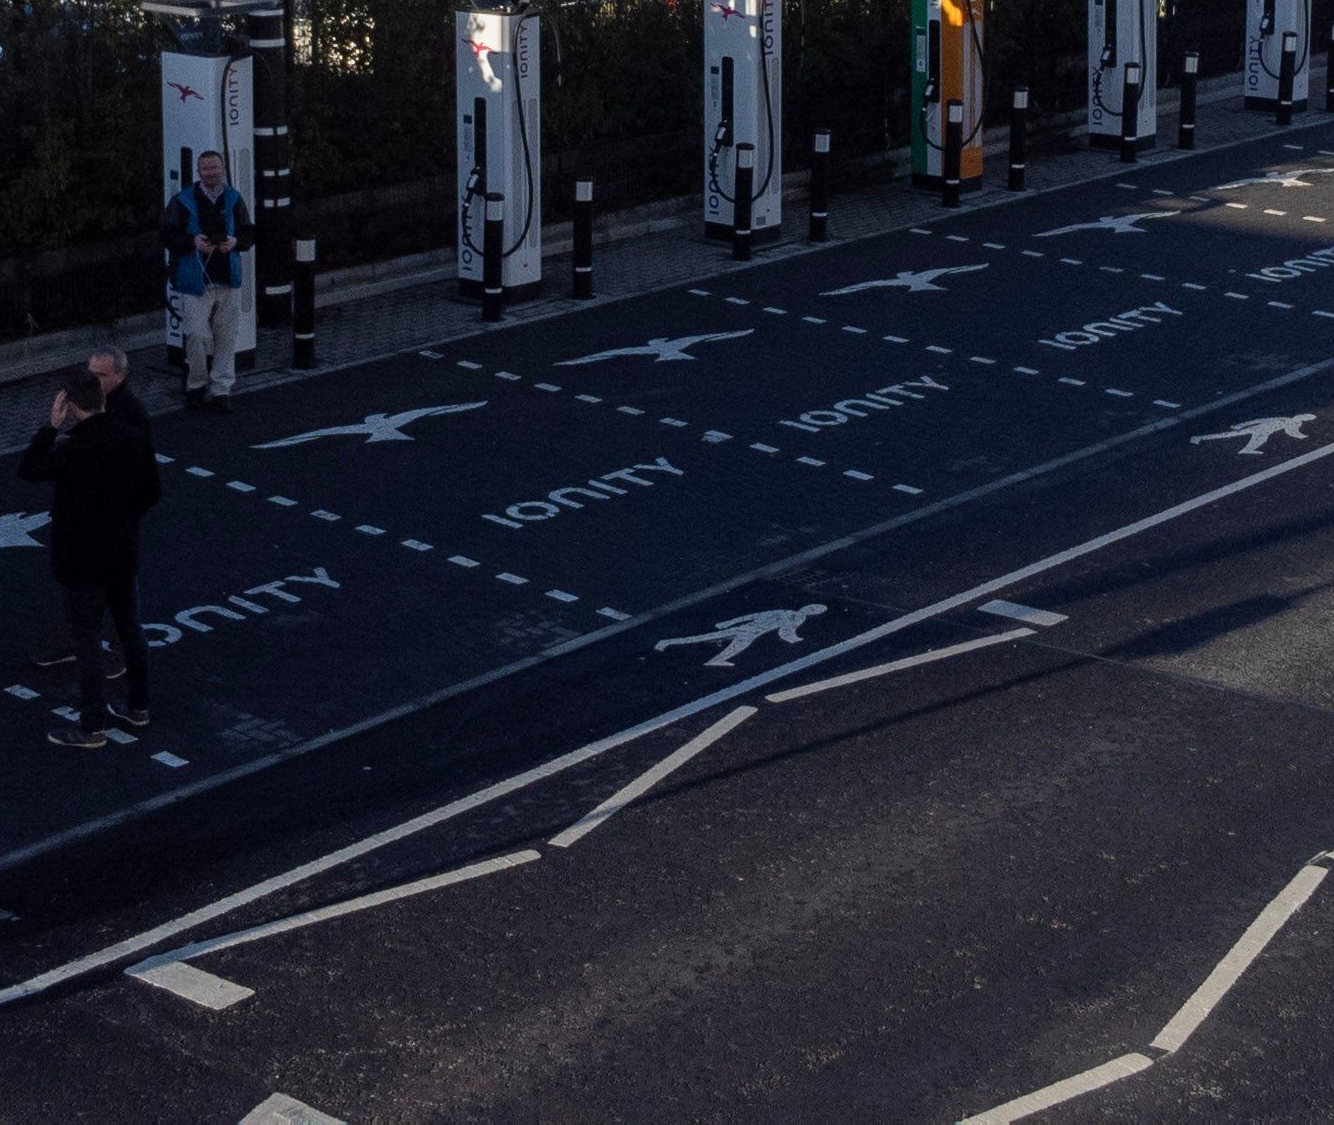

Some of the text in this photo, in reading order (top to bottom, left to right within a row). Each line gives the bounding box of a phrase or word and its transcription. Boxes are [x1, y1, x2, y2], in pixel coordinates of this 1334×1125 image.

[519, 25, 528, 79] IONITY
[228, 66, 239, 127] IONITY
[1038, 300, 1184, 351] IONITY
[778, 375, 950, 433] IONITY
[481, 456, 685, 530] IONITY
[140, 566, 342, 648] ONITY
